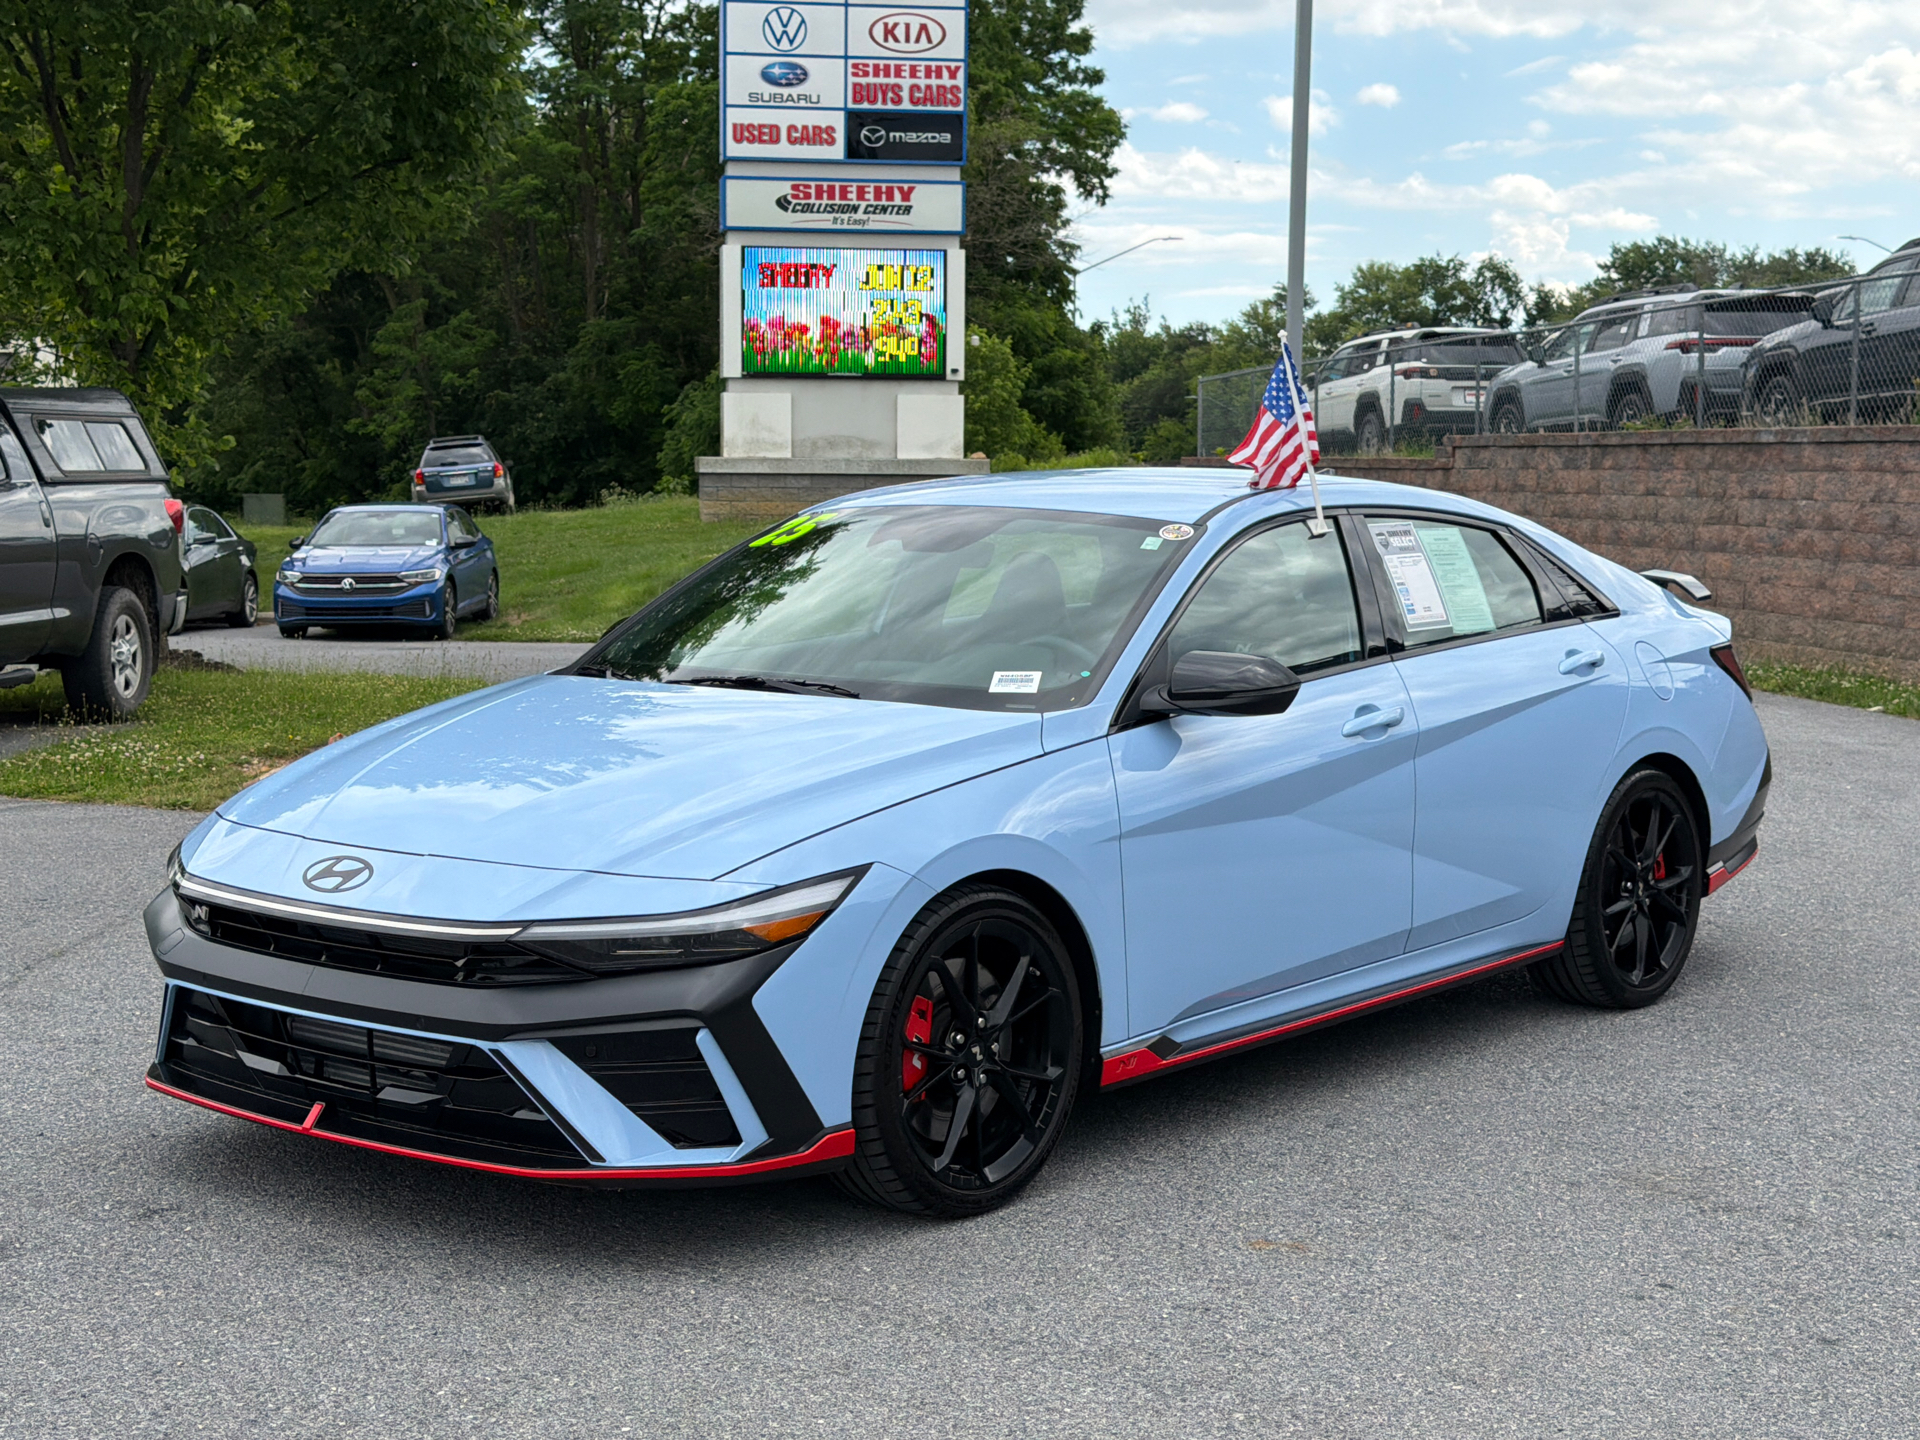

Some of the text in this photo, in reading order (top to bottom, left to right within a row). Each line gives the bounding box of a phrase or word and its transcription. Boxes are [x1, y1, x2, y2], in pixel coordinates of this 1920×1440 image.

[882, 22, 934, 45] KIA
[851, 62, 962, 80] SHEEHY
[748, 92, 821, 105] SUBARU
[852, 82, 962, 107] BUYS CARS
[732, 123, 837, 147] USED CARS
[889, 131, 952, 143] mazda
[790, 183, 917, 203] SHEEHY
[790, 202, 914, 216] COLLISION CENTER
[831, 216, 871, 228] It's Easy!
[748, 513, 838, 547] 25
[1390, 537, 1416, 547] SELECT
